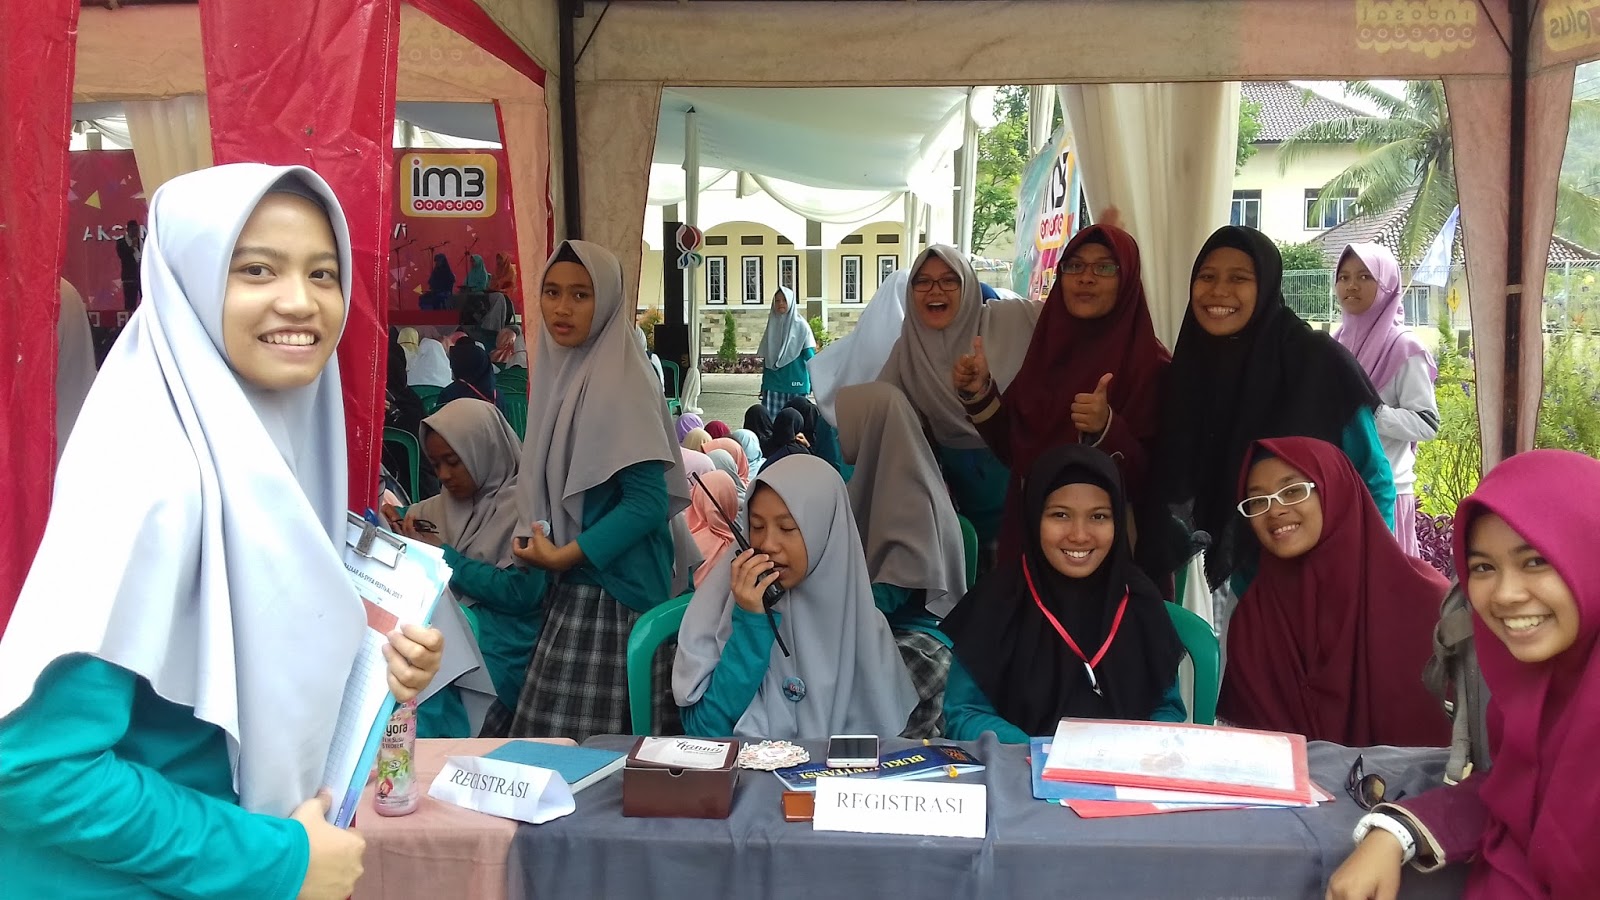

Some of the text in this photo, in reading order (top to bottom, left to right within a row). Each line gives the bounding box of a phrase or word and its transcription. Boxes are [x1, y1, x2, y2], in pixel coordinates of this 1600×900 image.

[413, 199, 484, 211] ooredoo
[384, 723, 408, 736] yora
[880, 754, 926, 769] BUKU
[450, 769, 530, 799] REGISTRASI
[837, 792, 964, 814] REGISTRASI
